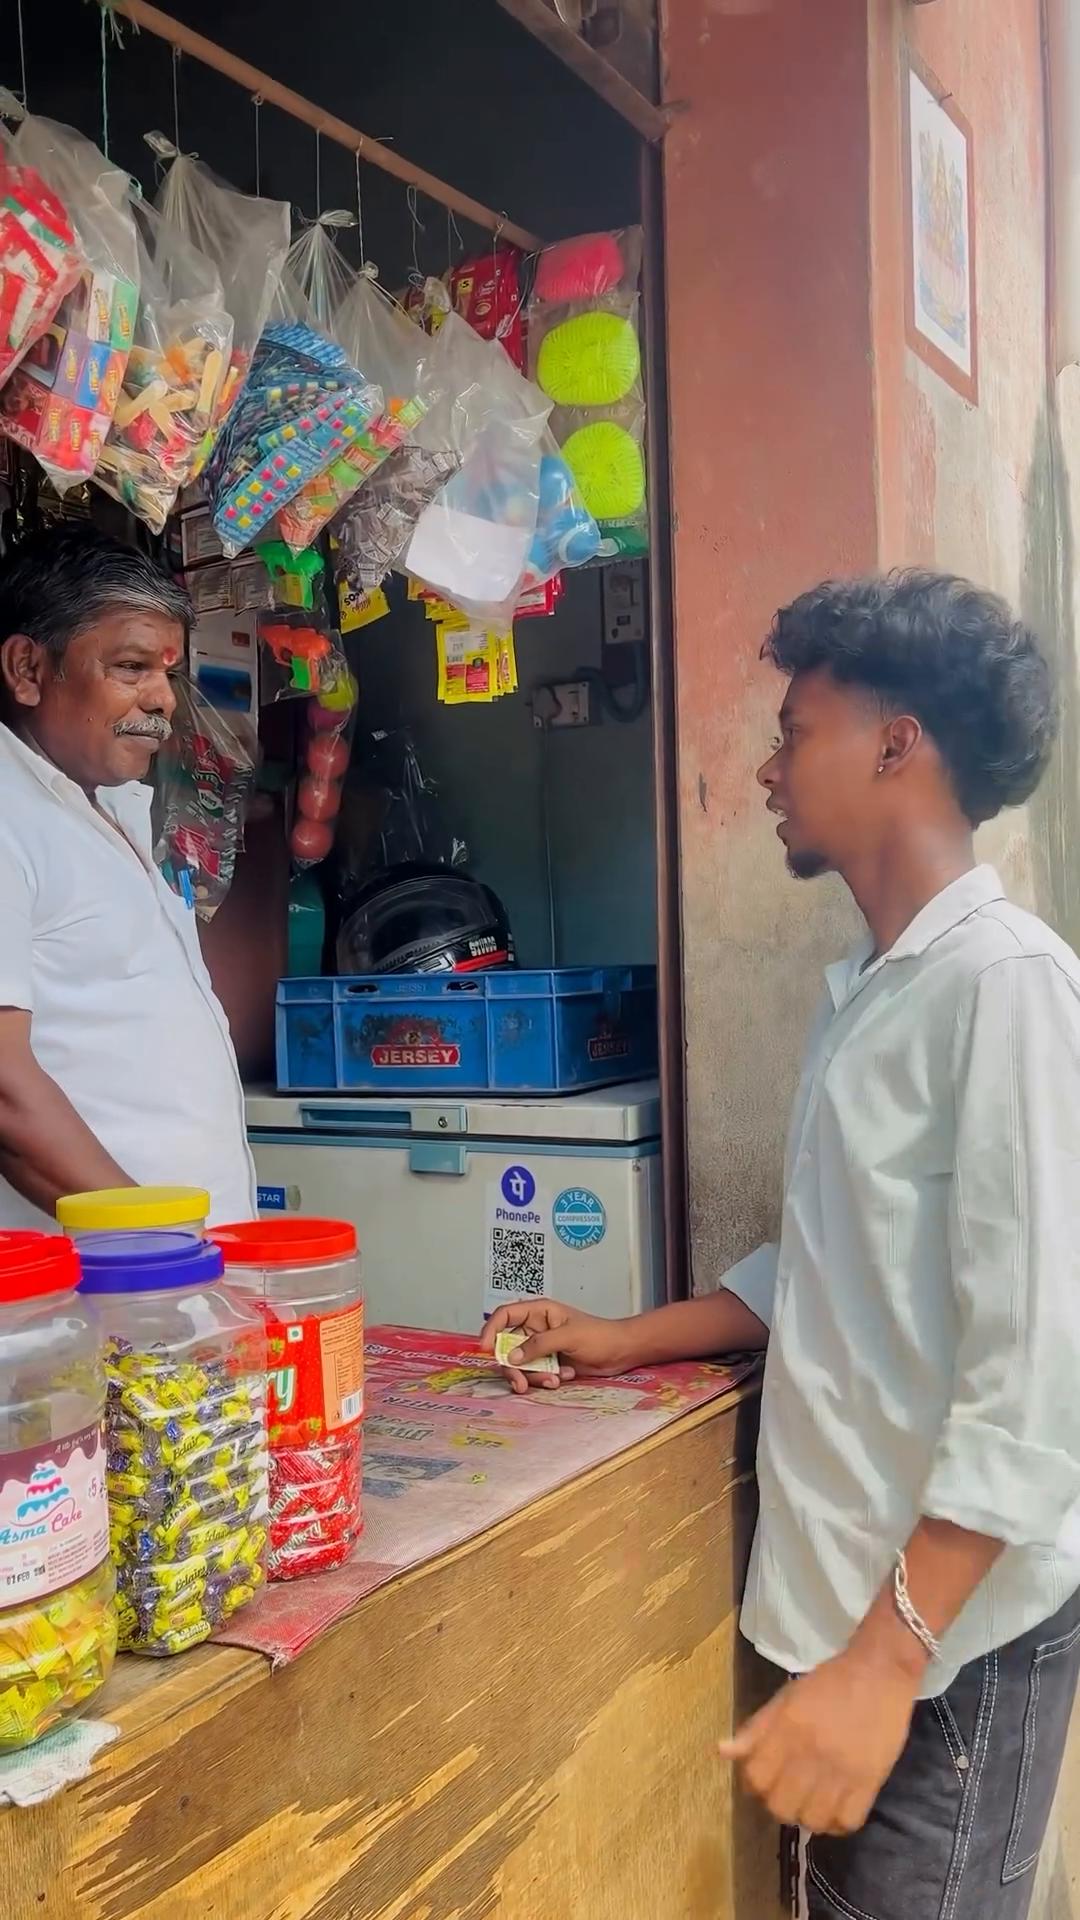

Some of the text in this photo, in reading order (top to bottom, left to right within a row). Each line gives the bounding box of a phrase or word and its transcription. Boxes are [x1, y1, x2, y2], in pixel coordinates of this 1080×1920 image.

[378, 1049, 454, 1065] JERSEY
[560, 1191, 595, 1208] 3 YEAR
[496, 1208, 541, 1224] PhonePe
[557, 1215, 601, 1223] COMPRESSOR
[558, 1226, 600, 1248] WARRANTY
[0, 1509, 83, 1545] Asma Cake
